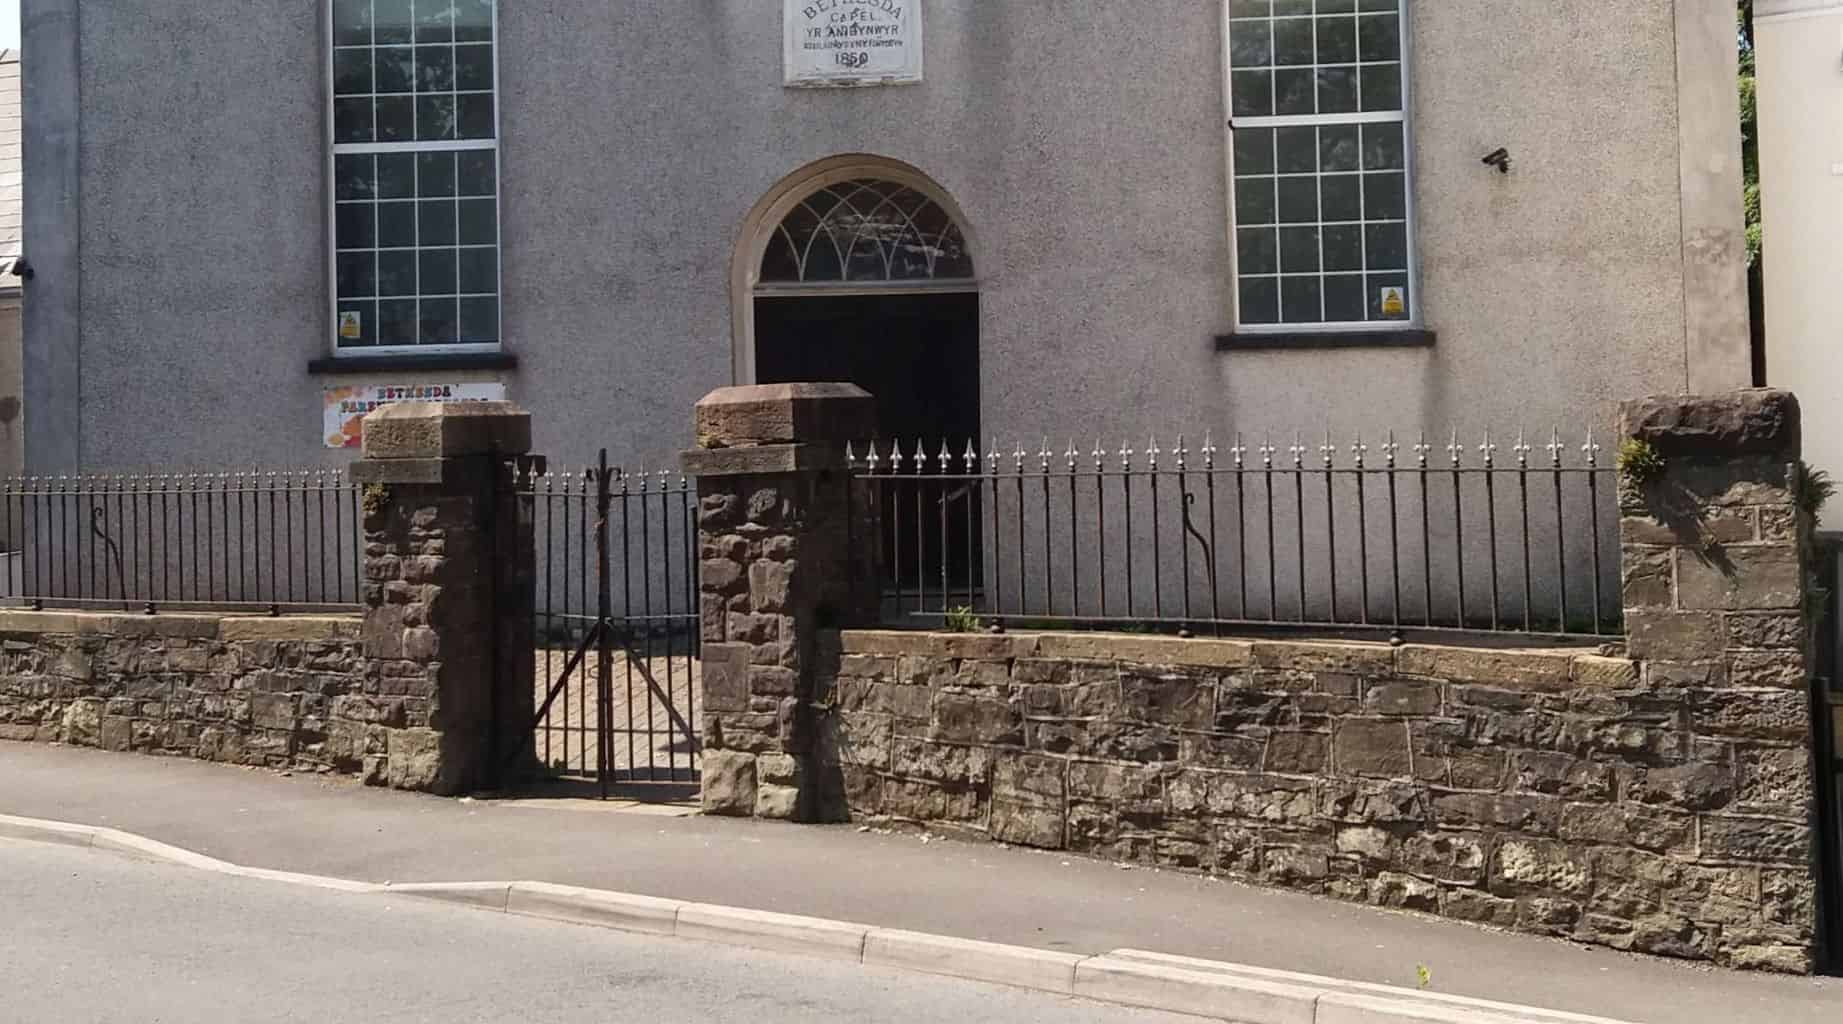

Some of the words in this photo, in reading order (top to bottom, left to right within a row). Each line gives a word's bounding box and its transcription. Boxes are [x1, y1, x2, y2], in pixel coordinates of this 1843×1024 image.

[830, 11, 877, 23] CAPEL
[806, 27, 821, 38] YR
[377, 385, 452, 399] BETHESDA
